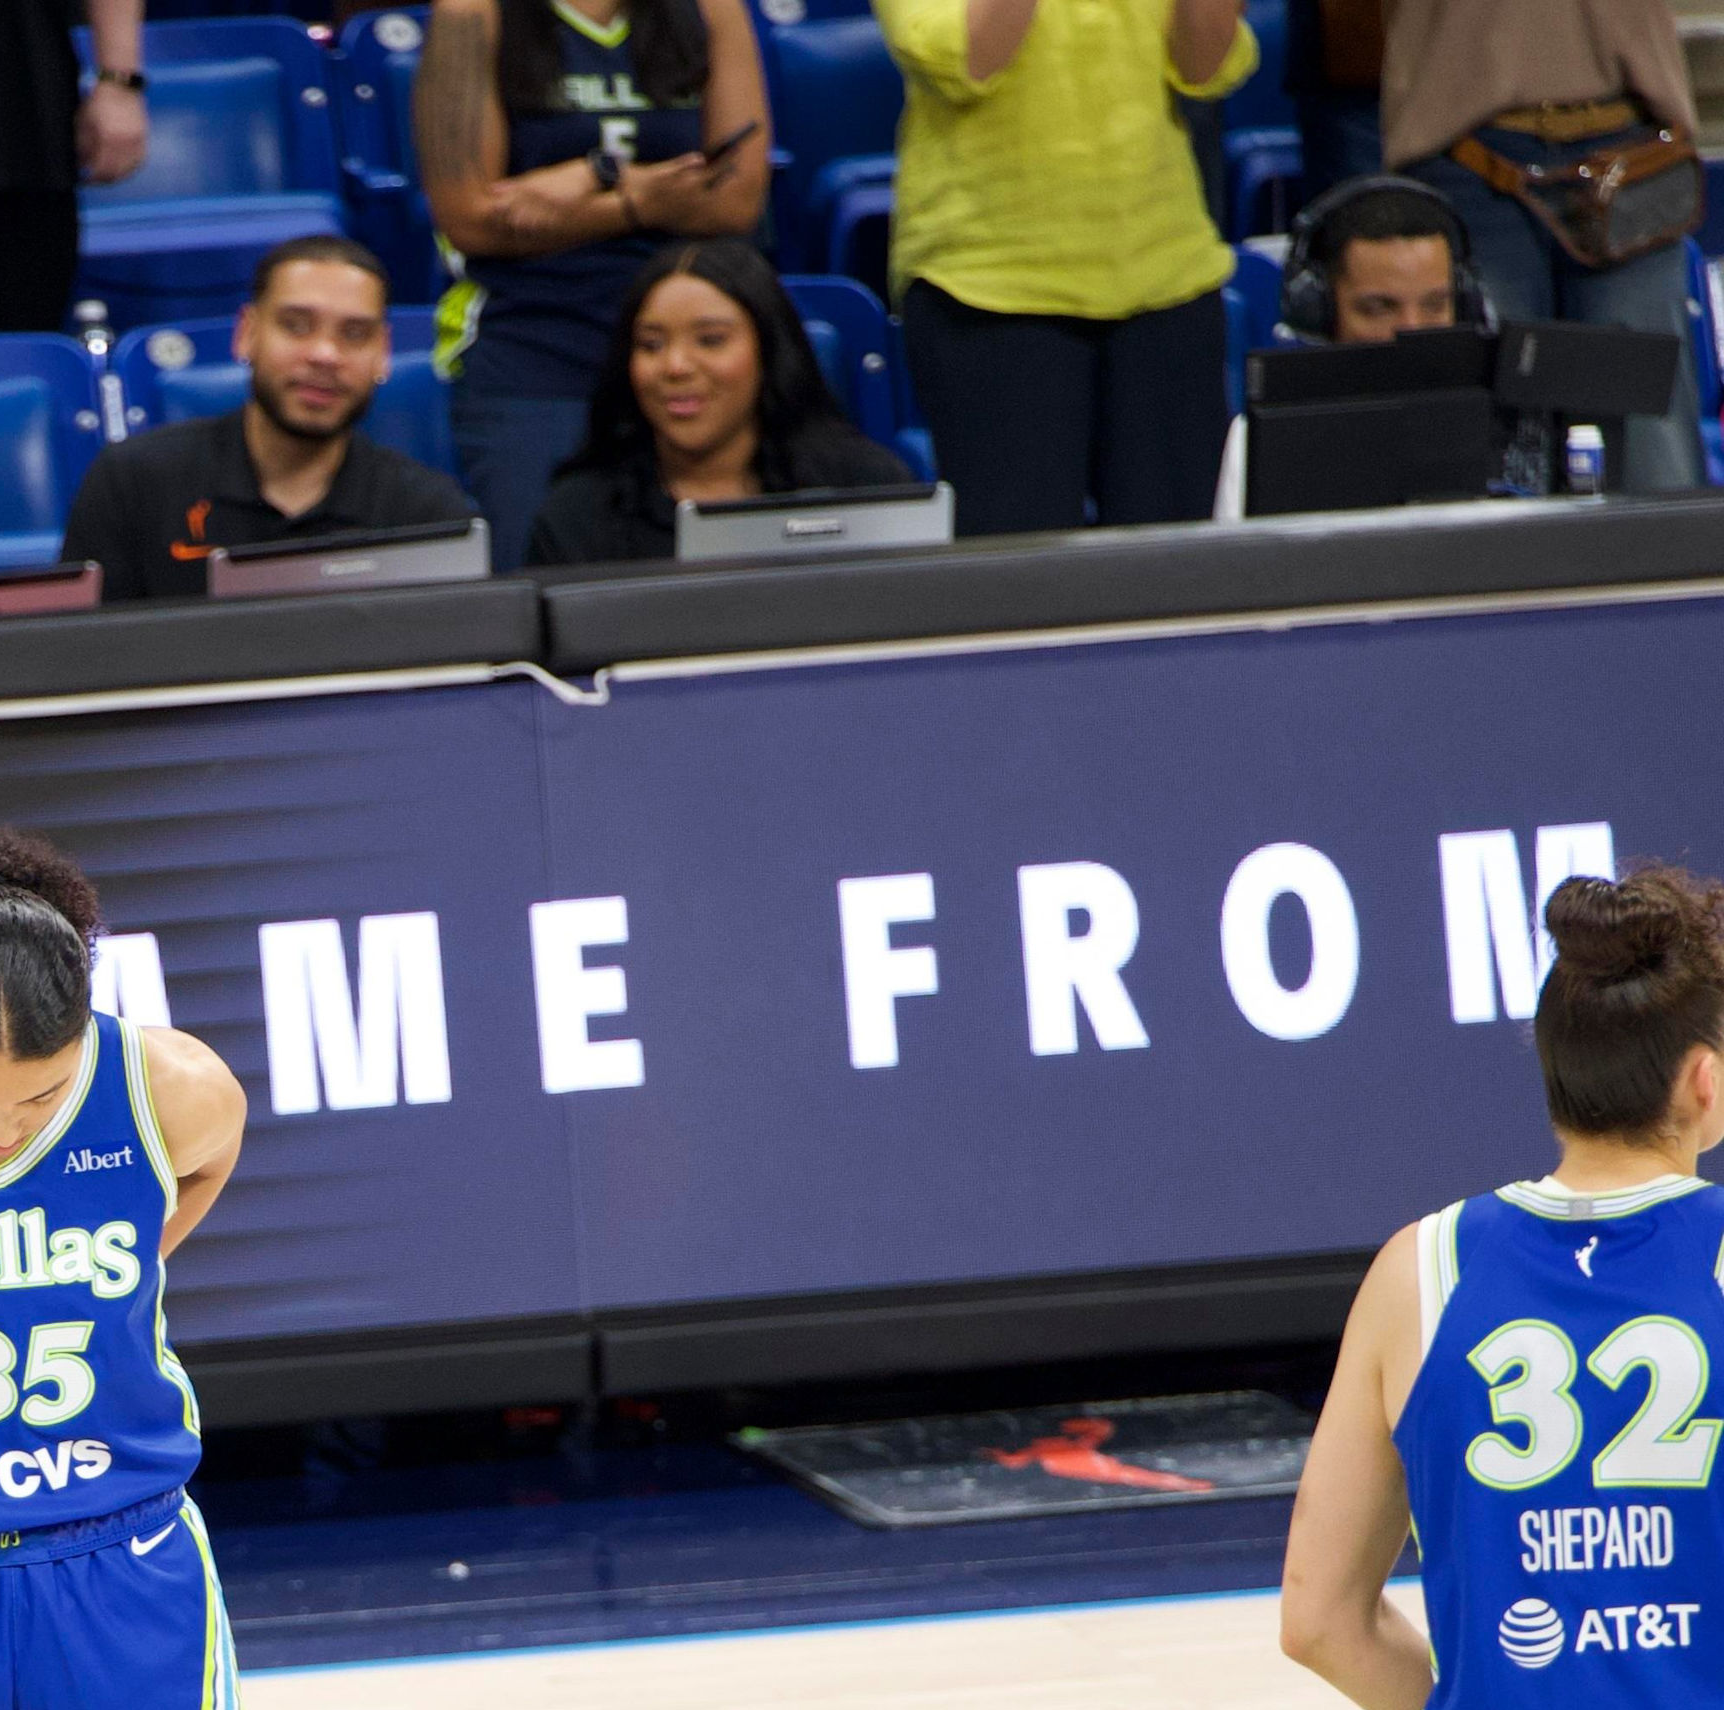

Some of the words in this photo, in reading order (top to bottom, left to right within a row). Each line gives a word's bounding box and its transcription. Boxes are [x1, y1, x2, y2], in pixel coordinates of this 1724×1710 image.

[836, 821, 1616, 1071] FROM
[63, 1145, 134, 1175] Albert
[1464, 1314, 1724, 1491] 32
[1518, 1504, 1675, 1574] SHEPARD
[1575, 1602, 1701, 1654] AT&T
